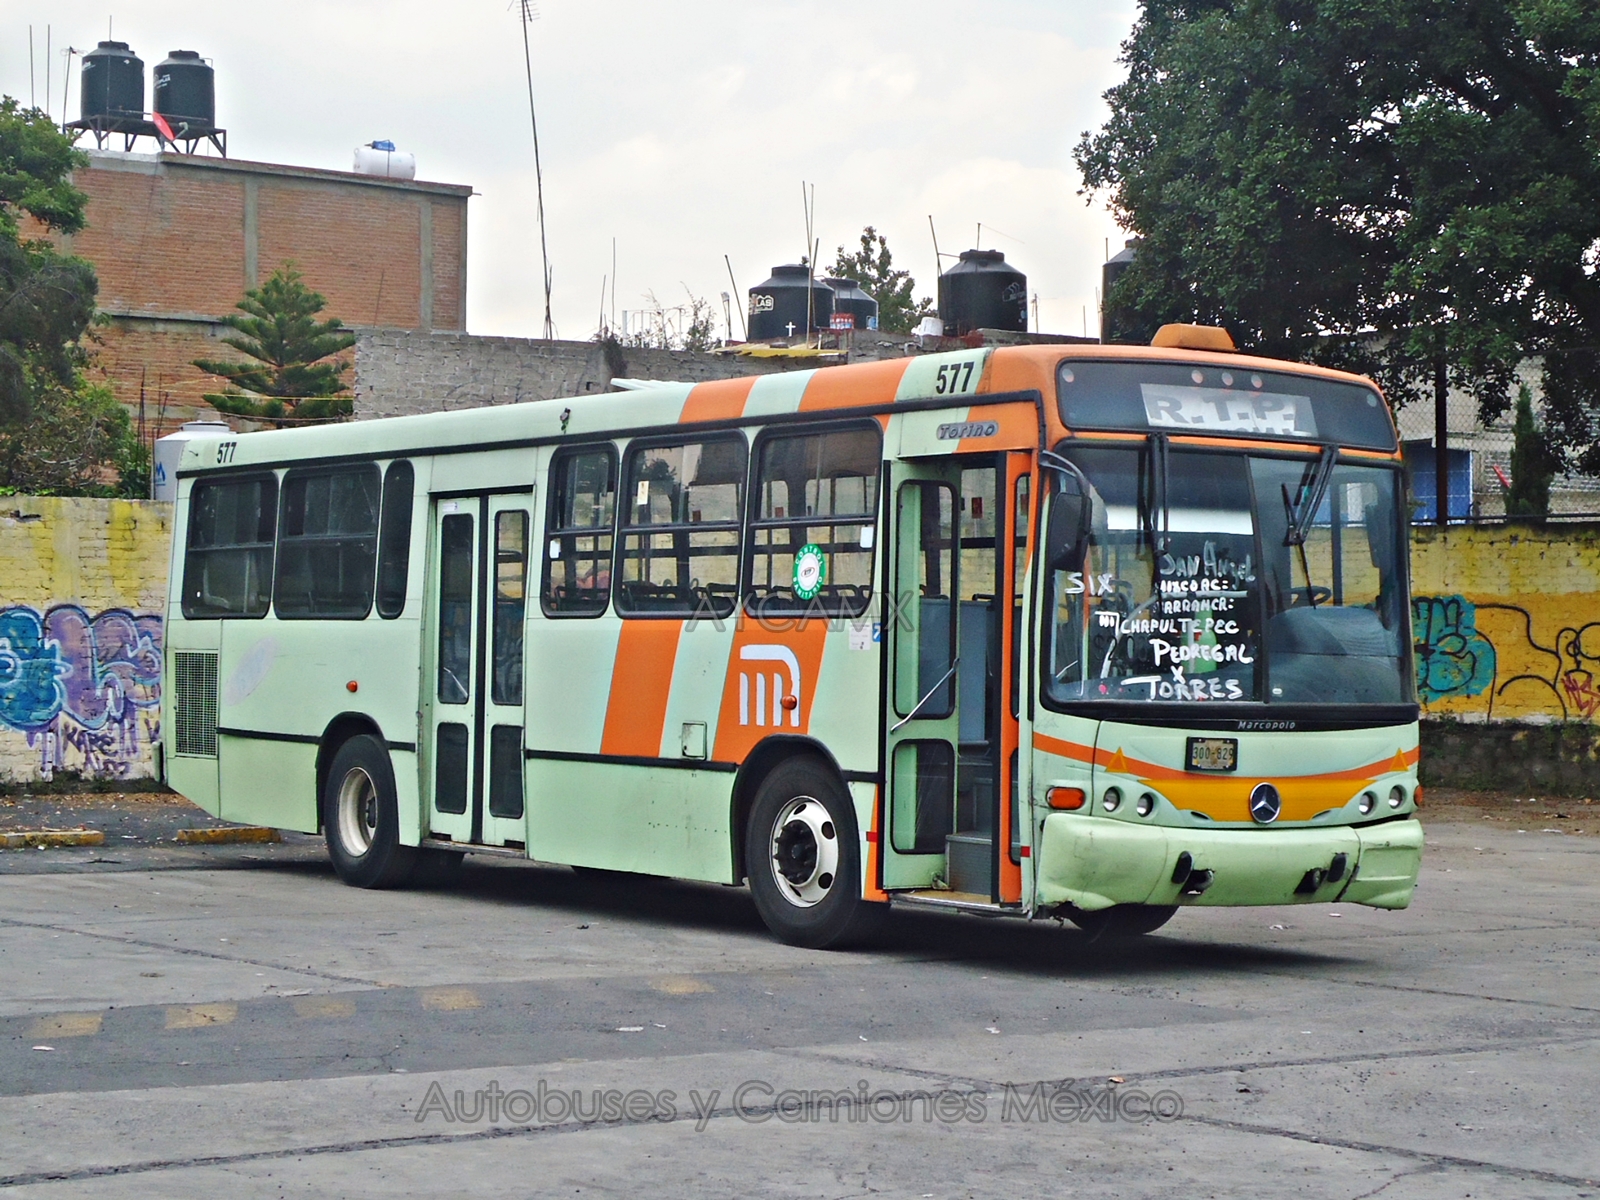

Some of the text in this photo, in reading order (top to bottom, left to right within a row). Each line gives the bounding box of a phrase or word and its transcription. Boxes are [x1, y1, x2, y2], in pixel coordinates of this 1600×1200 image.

[936, 361, 975, 395] 577
[1149, 394, 1294, 424] R.T.P.
[940, 423, 996, 440] Torino
[217, 441, 237, 464] 577
[795, 545, 823, 567] CONTROL
[1120, 617, 1240, 635] CHAPULTEPEC
[1120, 675, 1244, 700] TORRES
[1238, 721, 1296, 730] Marcopolo
